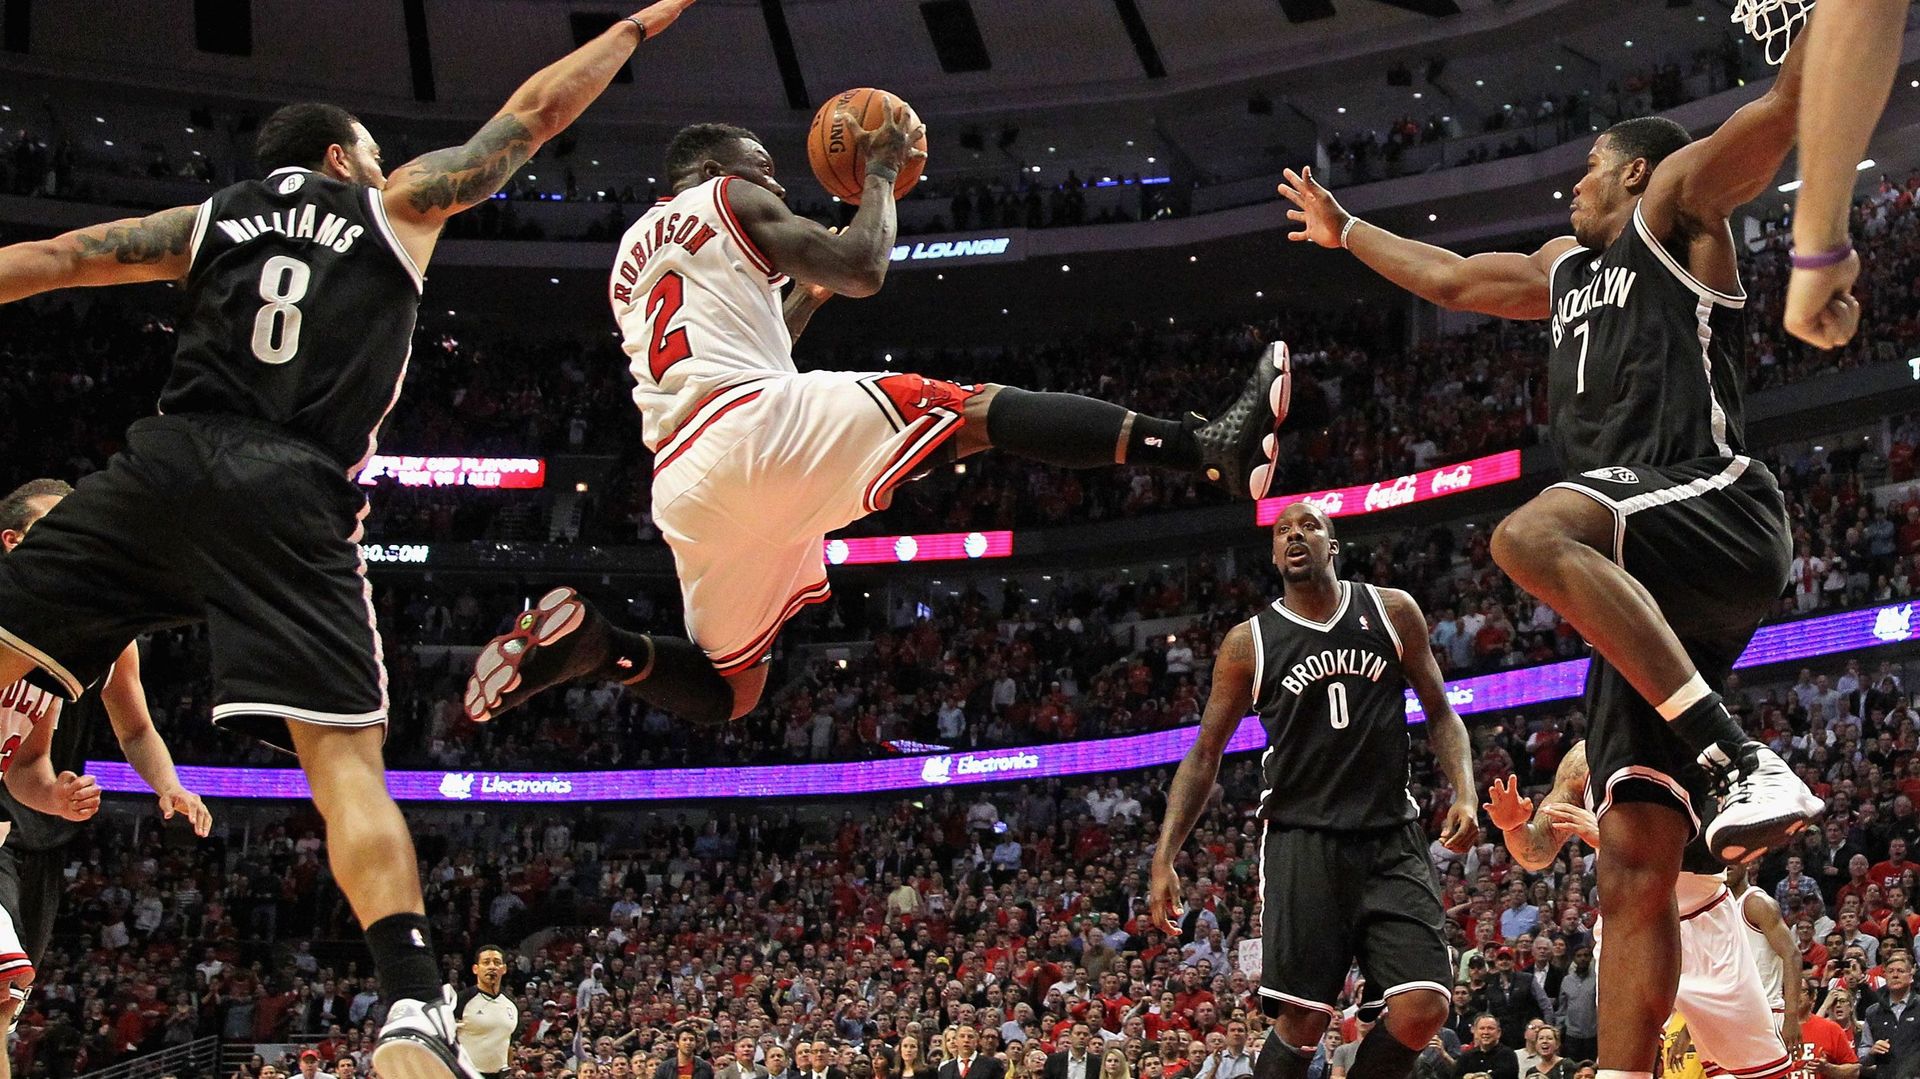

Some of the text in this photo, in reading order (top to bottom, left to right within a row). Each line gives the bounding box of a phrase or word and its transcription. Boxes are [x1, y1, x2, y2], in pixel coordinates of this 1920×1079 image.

[216, 203, 364, 253] WILLIAMS
[912, 238, 1009, 260] LOUNGE
[614, 203, 718, 306] ROBINSON
[251, 255, 311, 365] 8
[645, 269, 693, 385] 2
[1573, 320, 1590, 395] 7
[1281, 649, 1387, 696] BROOKLYN
[1327, 681, 1349, 730] 0
[957, 752, 1039, 774] Electronics
